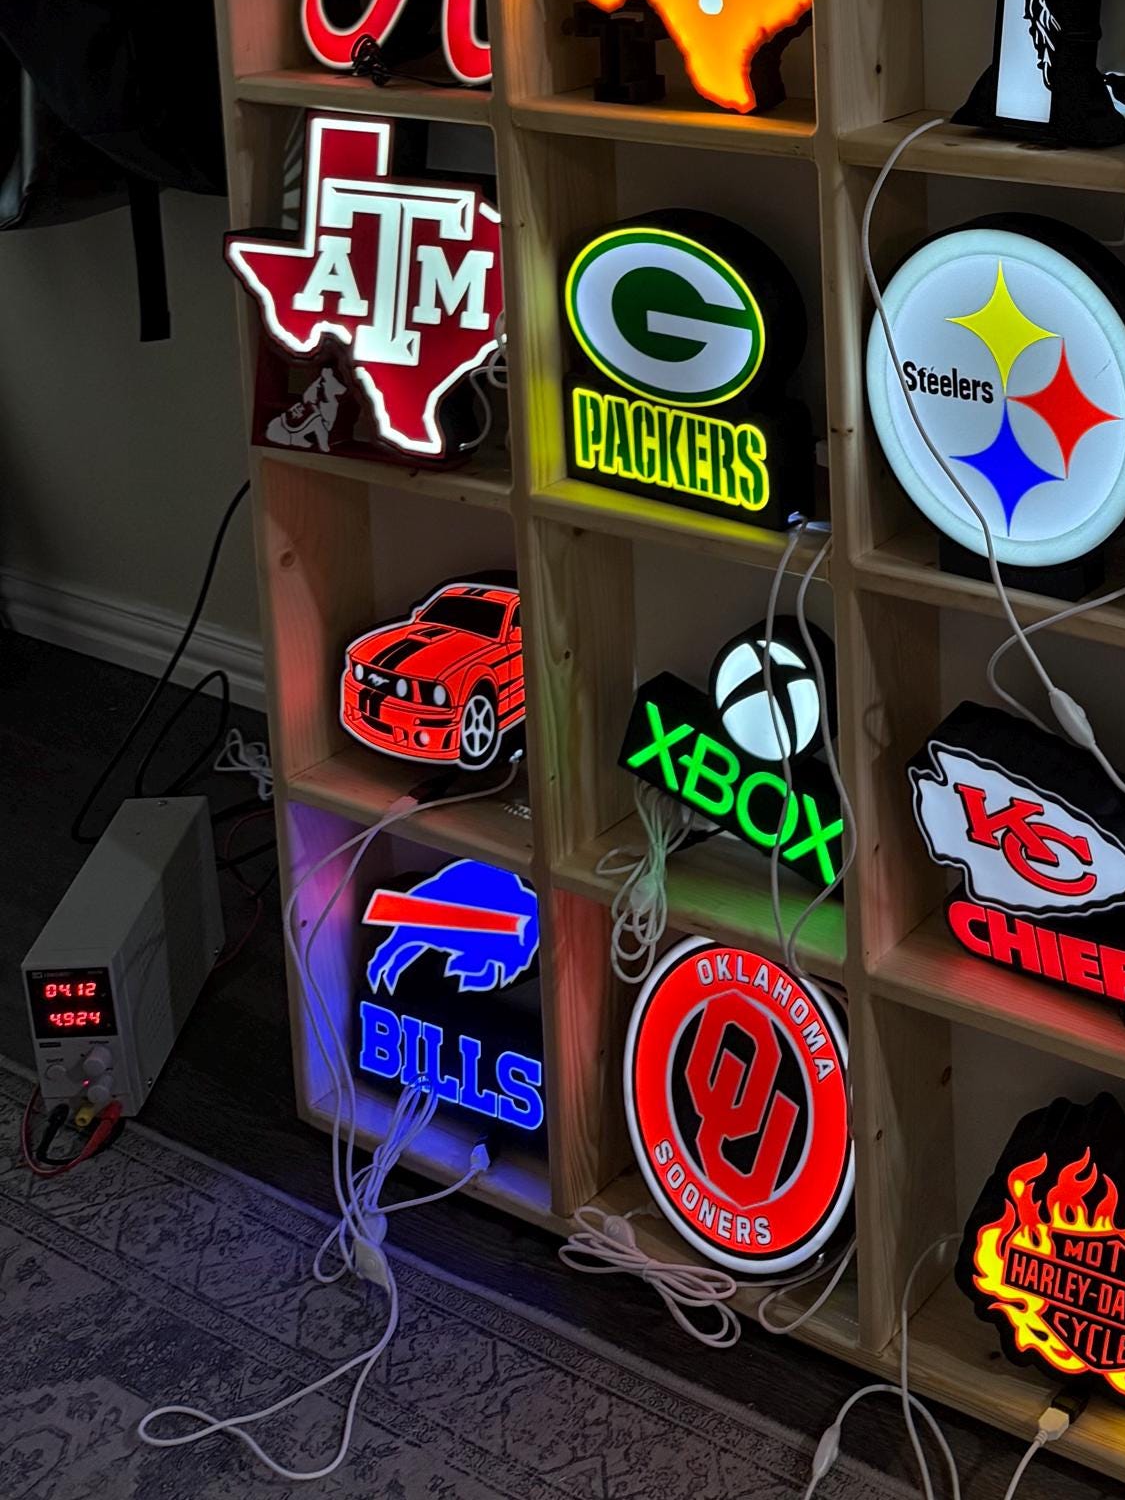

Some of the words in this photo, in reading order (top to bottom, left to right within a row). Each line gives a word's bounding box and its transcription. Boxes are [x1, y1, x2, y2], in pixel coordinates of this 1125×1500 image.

[576, 242, 753, 393] G
[902, 360, 994, 404] Steelers
[572, 387, 769, 511] PACKERS
[627, 701, 843, 886] XBOX
[954, 783, 1097, 897] KC
[359, 1000, 544, 1131] BILLS
[696, 955, 836, 1082] OKLAHOMA
[653, 1138, 773, 1246] SOONERS
